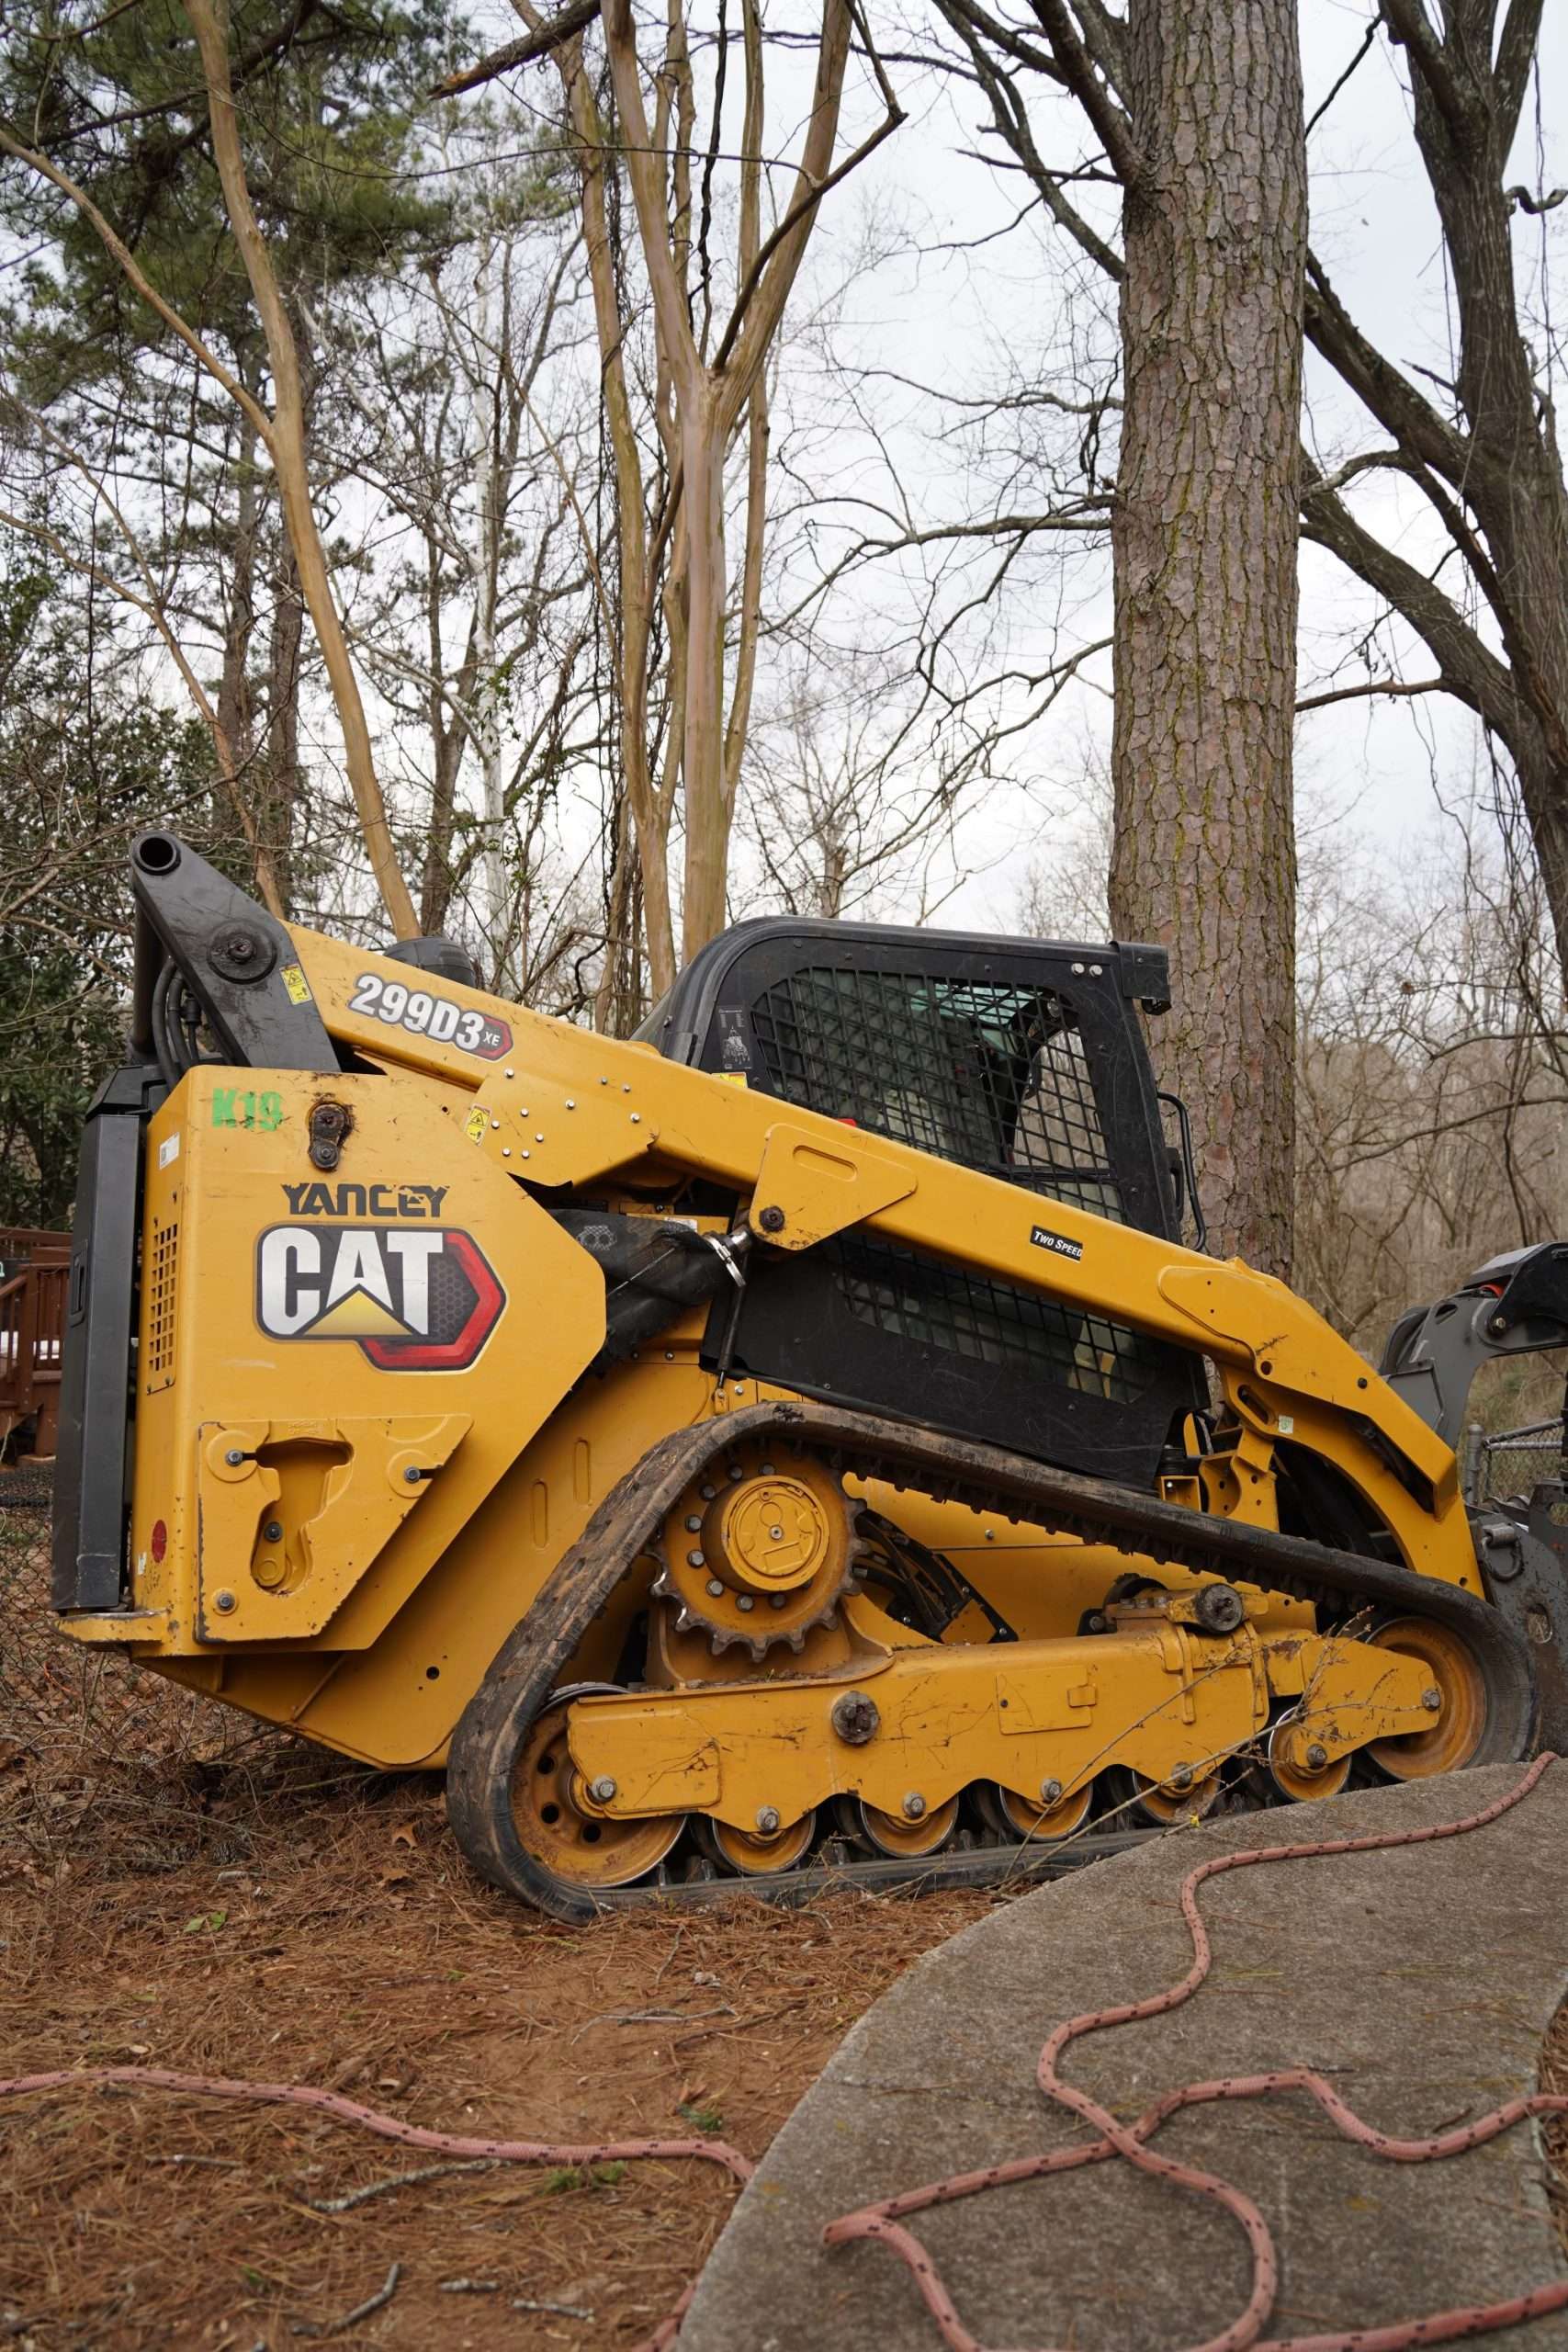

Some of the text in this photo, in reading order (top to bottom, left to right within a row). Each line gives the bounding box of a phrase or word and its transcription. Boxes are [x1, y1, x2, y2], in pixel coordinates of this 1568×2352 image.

[350, 974, 502, 1050] 299D3 XE
[212, 1087, 283, 1132] K19
[281, 1182, 450, 1217] YANCEY
[262, 1227, 444, 1336] CAT
